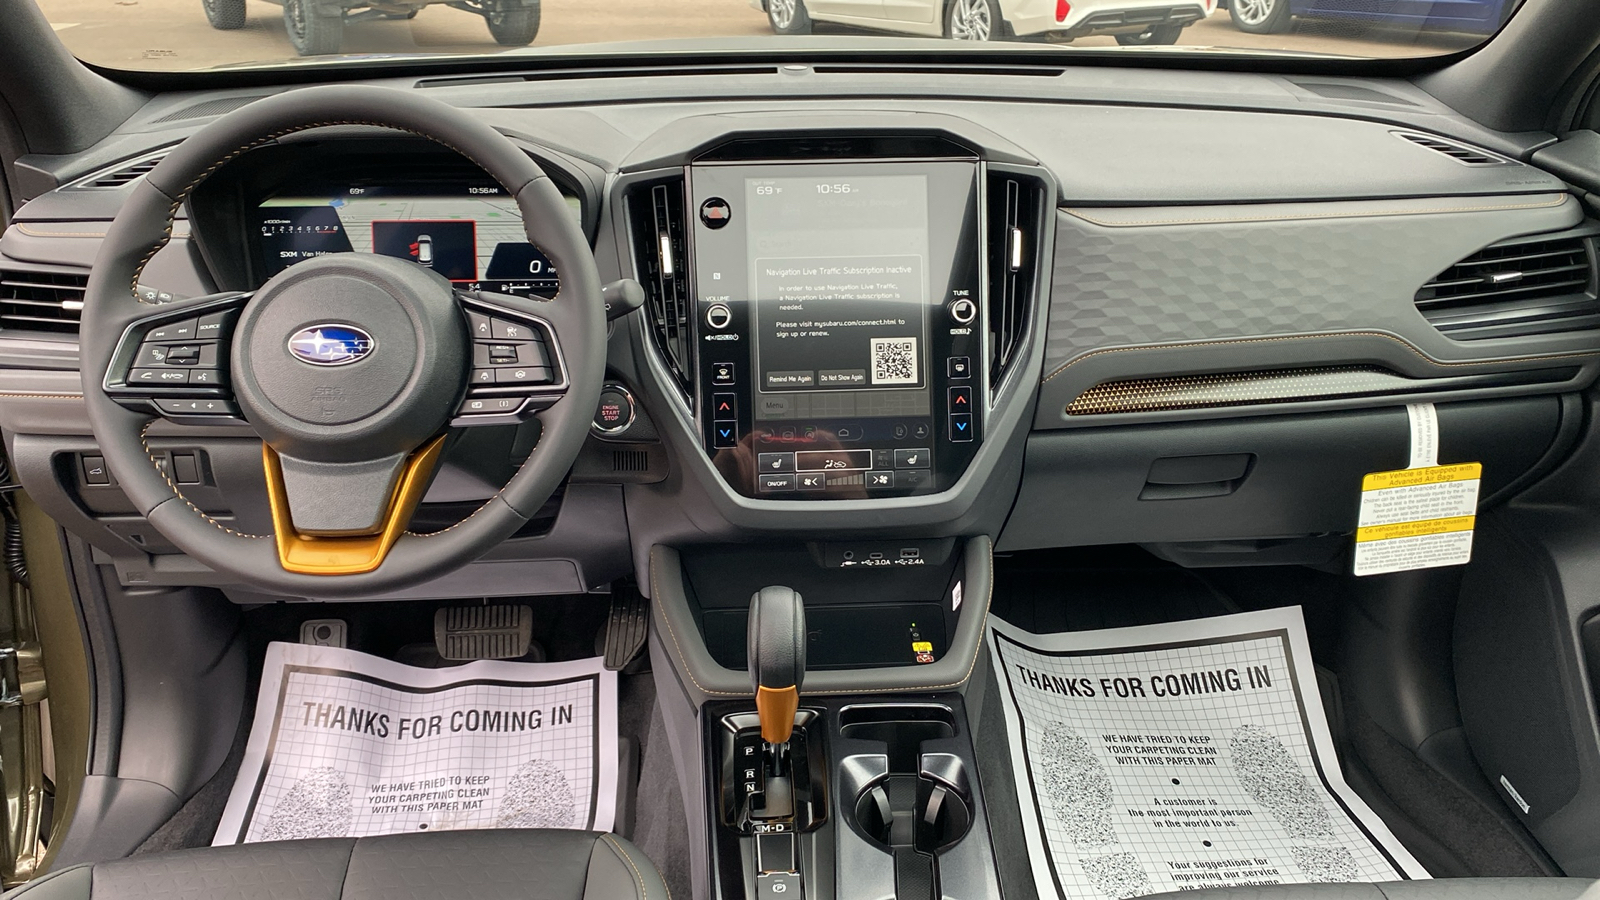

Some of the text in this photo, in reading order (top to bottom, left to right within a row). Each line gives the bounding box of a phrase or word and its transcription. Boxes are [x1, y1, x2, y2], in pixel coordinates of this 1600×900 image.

[756, 186, 773, 195] 69
[816, 184, 850, 194] 10:56
[530, 260, 541, 273] 0
[766, 268, 800, 277] Navigation
[843, 266, 884, 275] Subscription
[814, 319, 896, 328] mysubaru.com/connect.html
[1389, 470, 1414, 479] Vehicle
[1425, 467, 1457, 475] Equipped
[1389, 477, 1422, 486] Advanced
[1016, 664, 1273, 699] THANKS FOR COMING IN
[302, 702, 573, 740] THANKS FOR COMING IN
[1102, 734, 1118, 743] WE
[1119, 735, 1144, 743] HAVE
[1145, 735, 1172, 744] TRIED
[1173, 736, 1187, 744] TO
[1105, 746, 1217, 755] YOUR CARPETING CLEAN
[1115, 756, 1216, 766] WITH THIS PAPER MAT
[372, 776, 490, 793] WE HAVE TRIED TO KEEP
[369, 788, 490, 804] YOUR CARPETING CLEAN
[372, 800, 484, 814] WITH THIS PAPER MAT
[1154, 798, 1218, 806] A customer is
[1128, 808, 1252, 818] the most important person
[1152, 820, 1163, 828] in
[1182, 820, 1210, 828] world
[1167, 858, 1269, 870] Your suggestions for
[1171, 872, 1221, 882] improving
[1242, 868, 1279, 878] service
